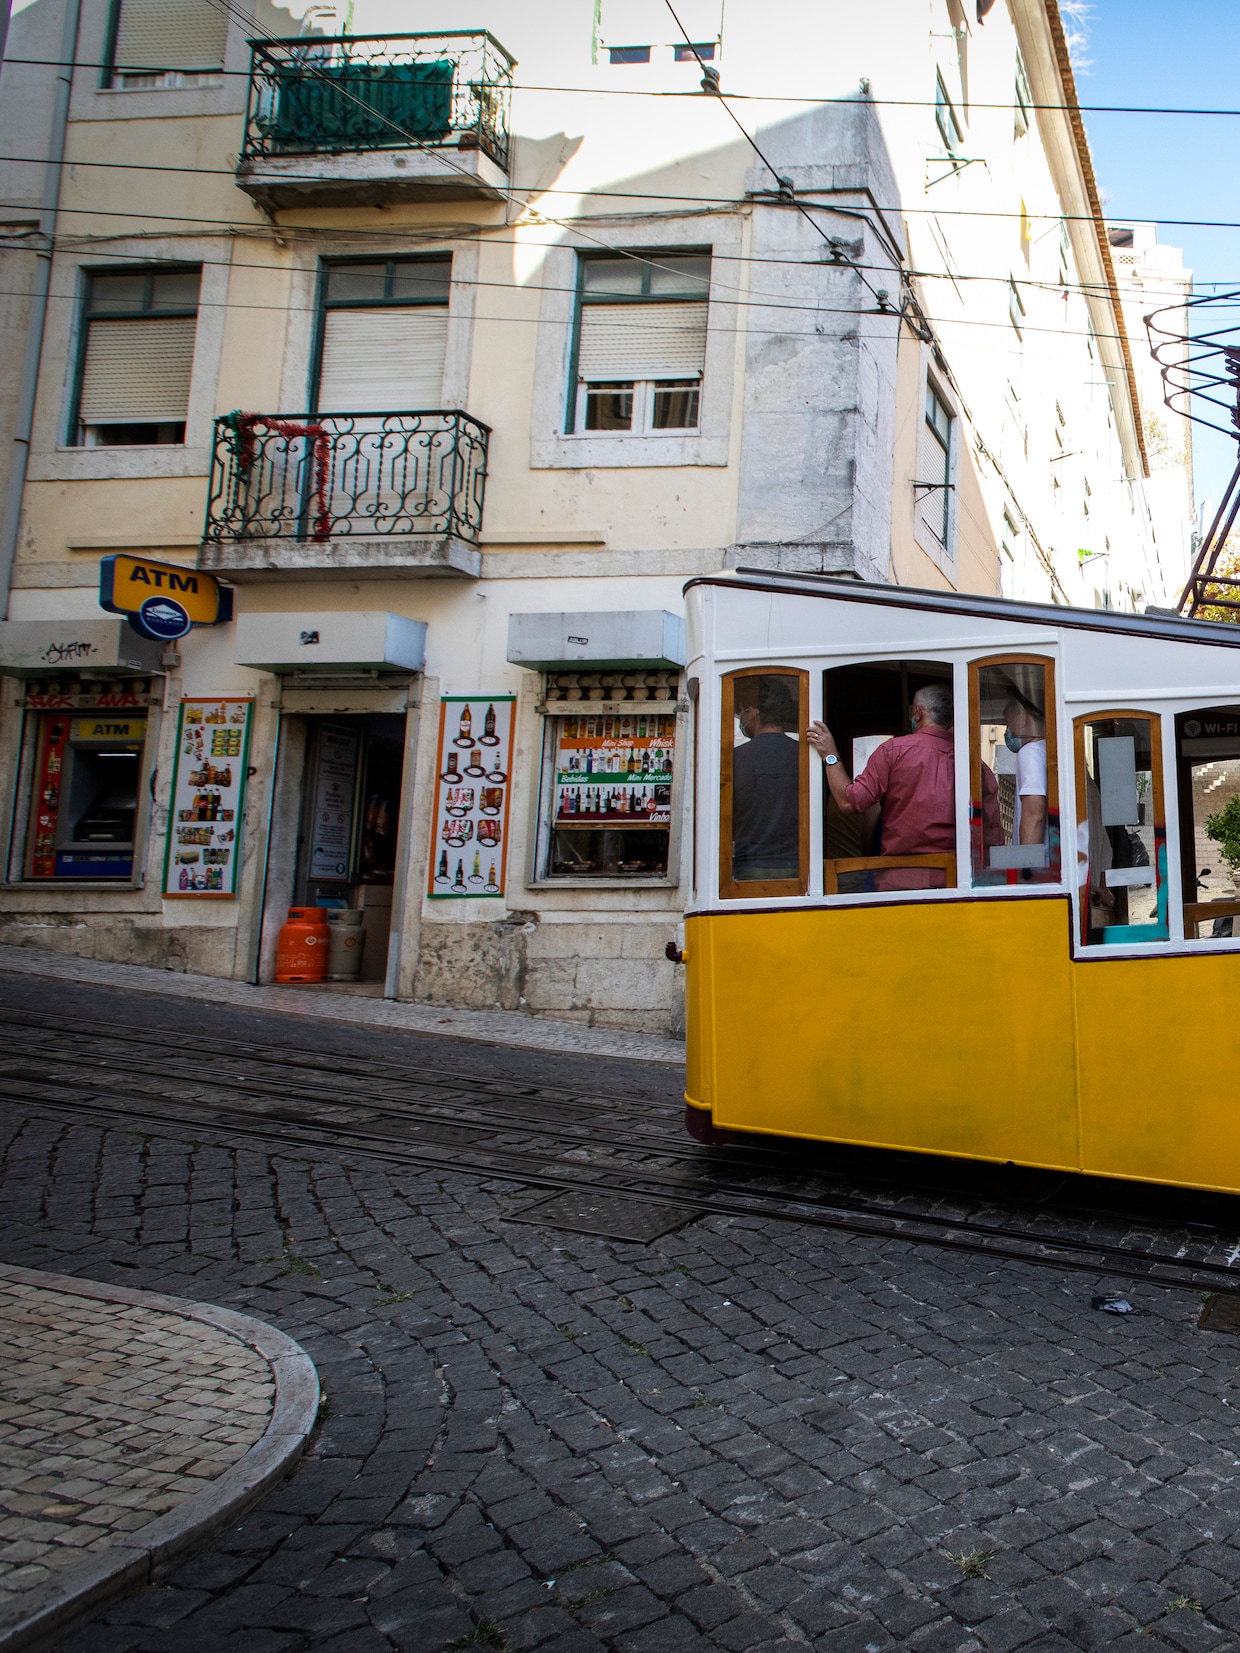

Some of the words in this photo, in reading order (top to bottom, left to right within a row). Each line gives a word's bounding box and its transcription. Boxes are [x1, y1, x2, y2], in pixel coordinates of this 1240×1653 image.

[129, 565, 198, 594] ATM
[92, 723, 129, 735] ATM
[1204, 722, 1238, 734] WI-FI
[617, 739, 634, 748] Shop
[560, 774, 589, 783] Bebidas
[642, 774, 672, 782] Mercado
